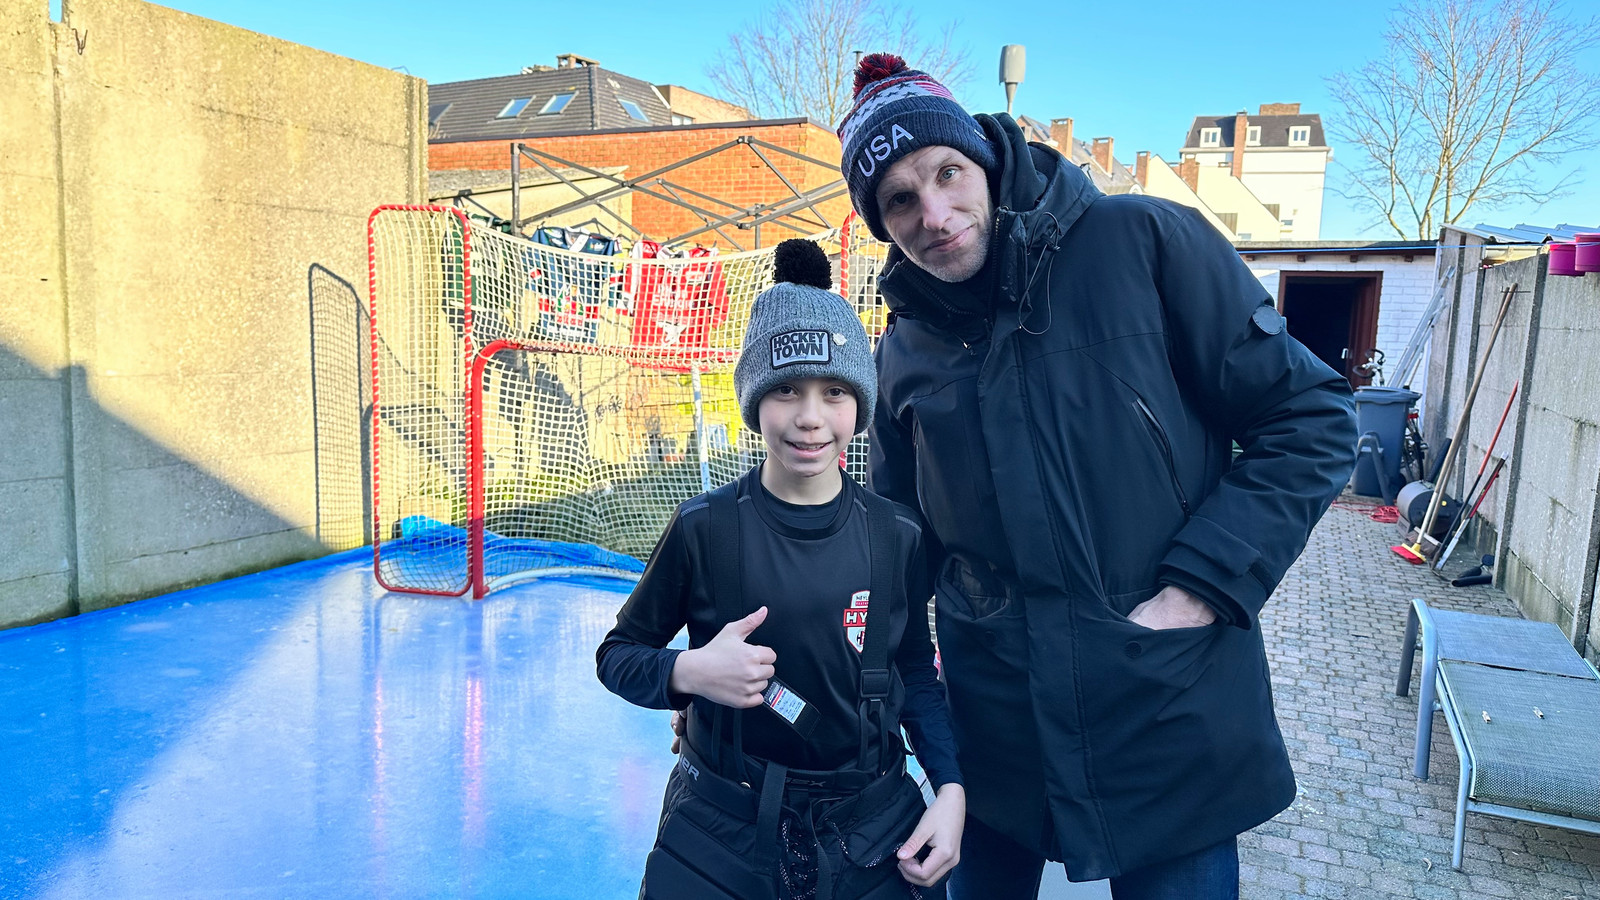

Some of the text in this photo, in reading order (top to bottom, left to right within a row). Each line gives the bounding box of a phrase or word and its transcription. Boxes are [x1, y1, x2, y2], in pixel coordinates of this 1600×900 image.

[858, 124, 914, 177] USA
[774, 333, 825, 348] HOCKEY
[774, 344, 823, 360] TOWN
